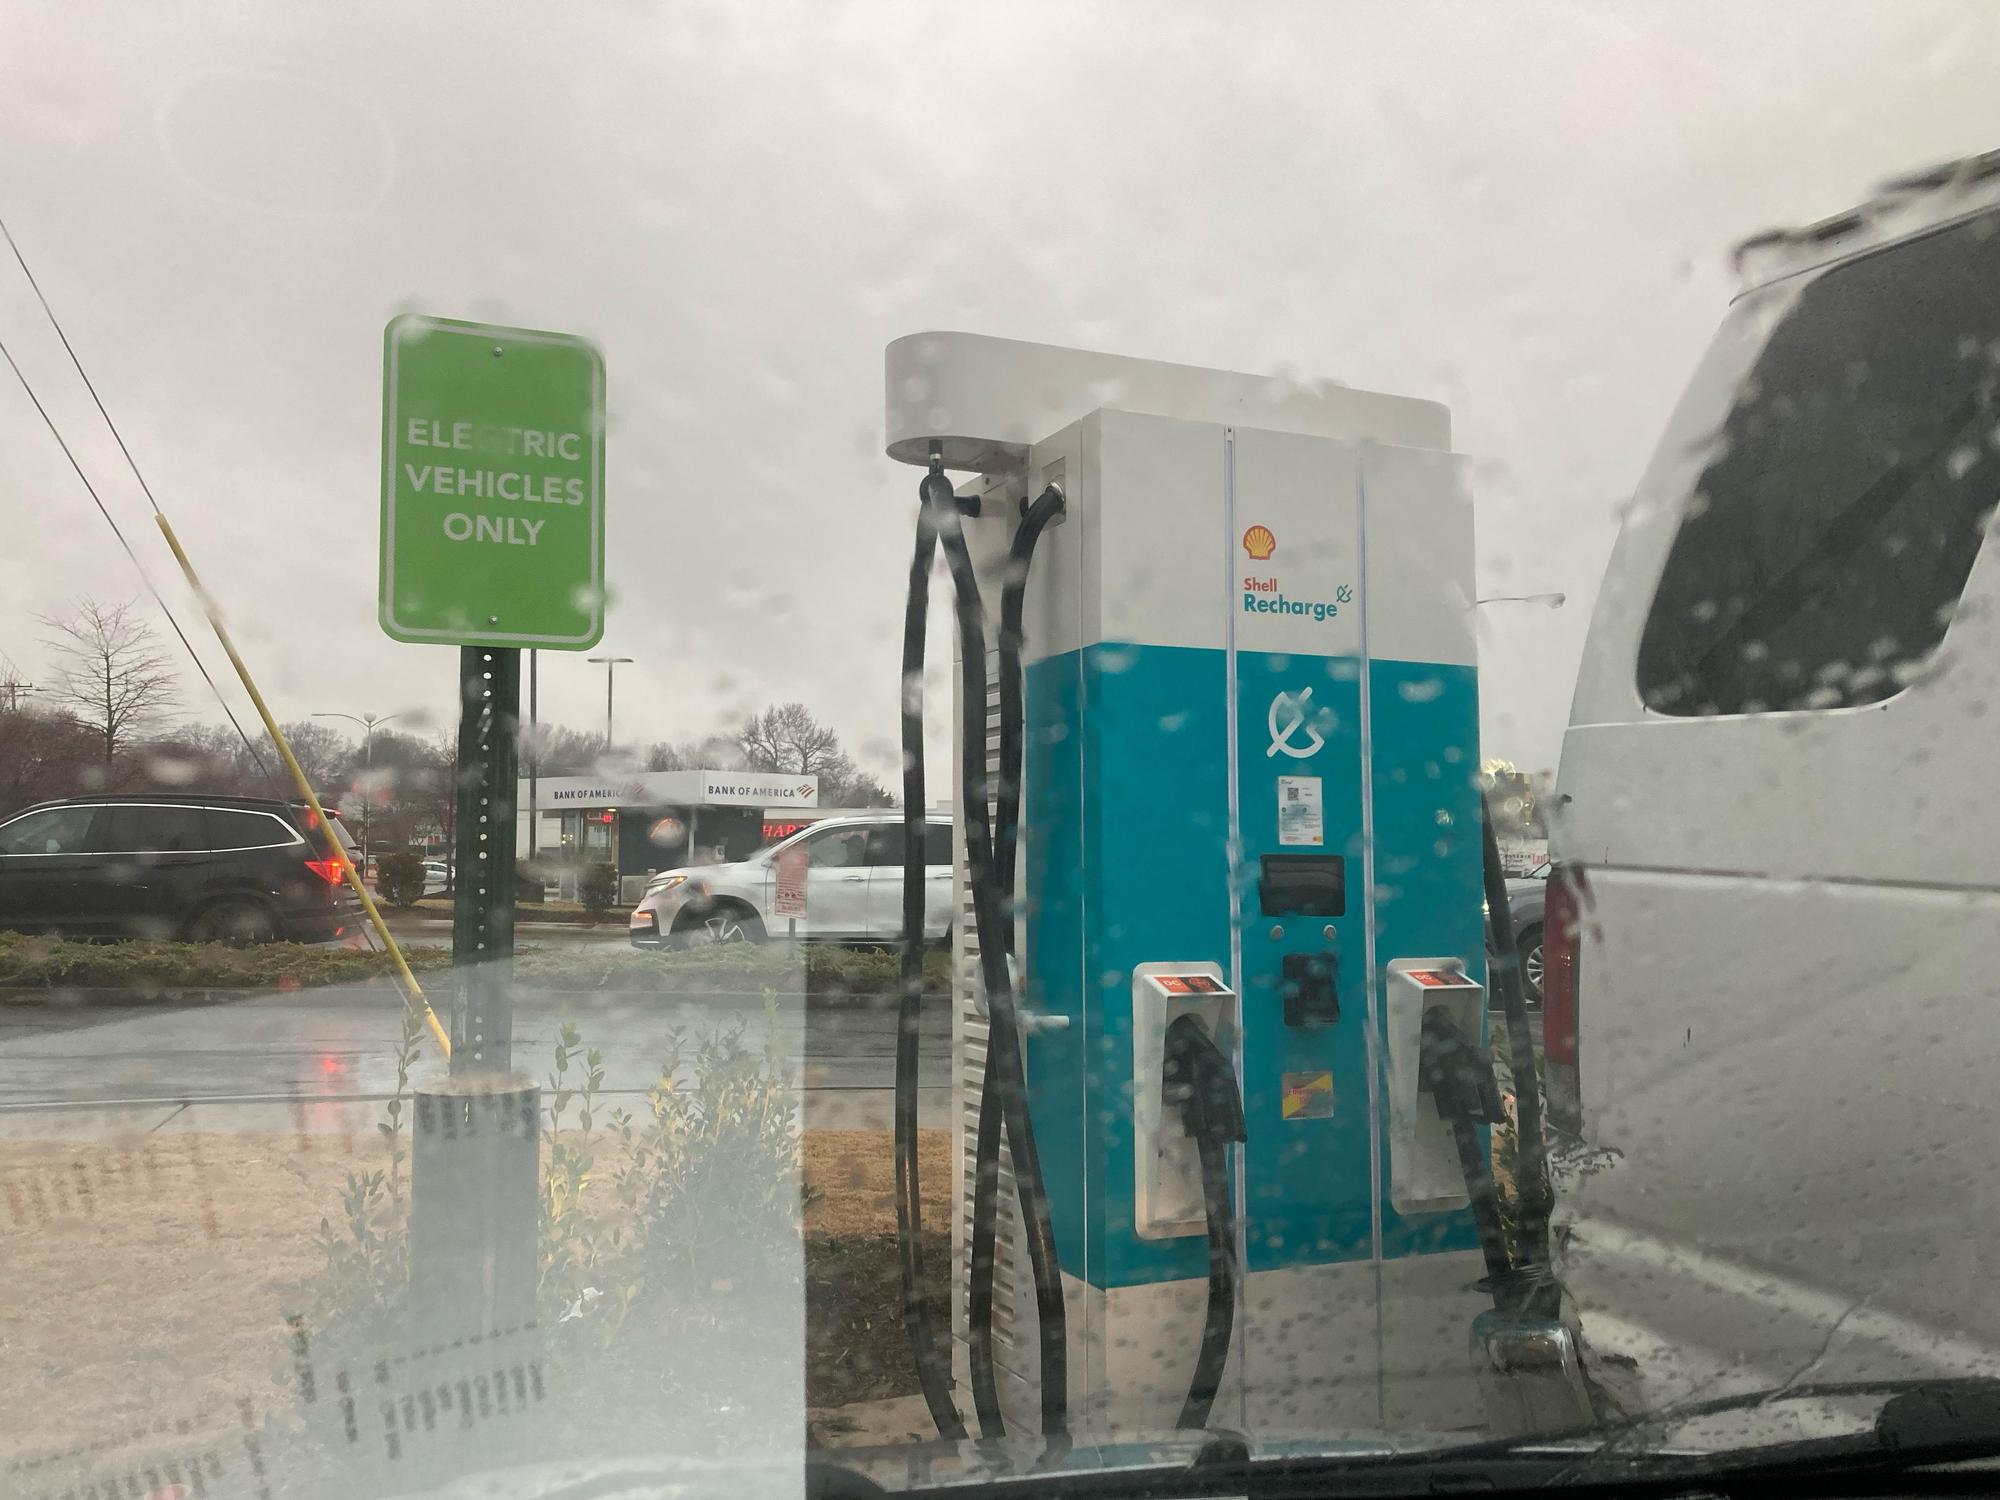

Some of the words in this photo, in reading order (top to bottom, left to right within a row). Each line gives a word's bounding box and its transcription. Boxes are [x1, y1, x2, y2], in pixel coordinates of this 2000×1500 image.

[407, 417, 581, 461] ELETRIC
[405, 464, 584, 506] VEHICLES
[443, 512, 546, 546] ONLY
[1244, 577, 1277, 593] Shell
[1244, 593, 1338, 622] Recharge
[554, 791, 575, 800] BANK
[577, 790, 588, 799] OF
[708, 785, 736, 796] BANK
[738, 787, 751, 796] OF
[752, 787, 795, 798] AMERICA
